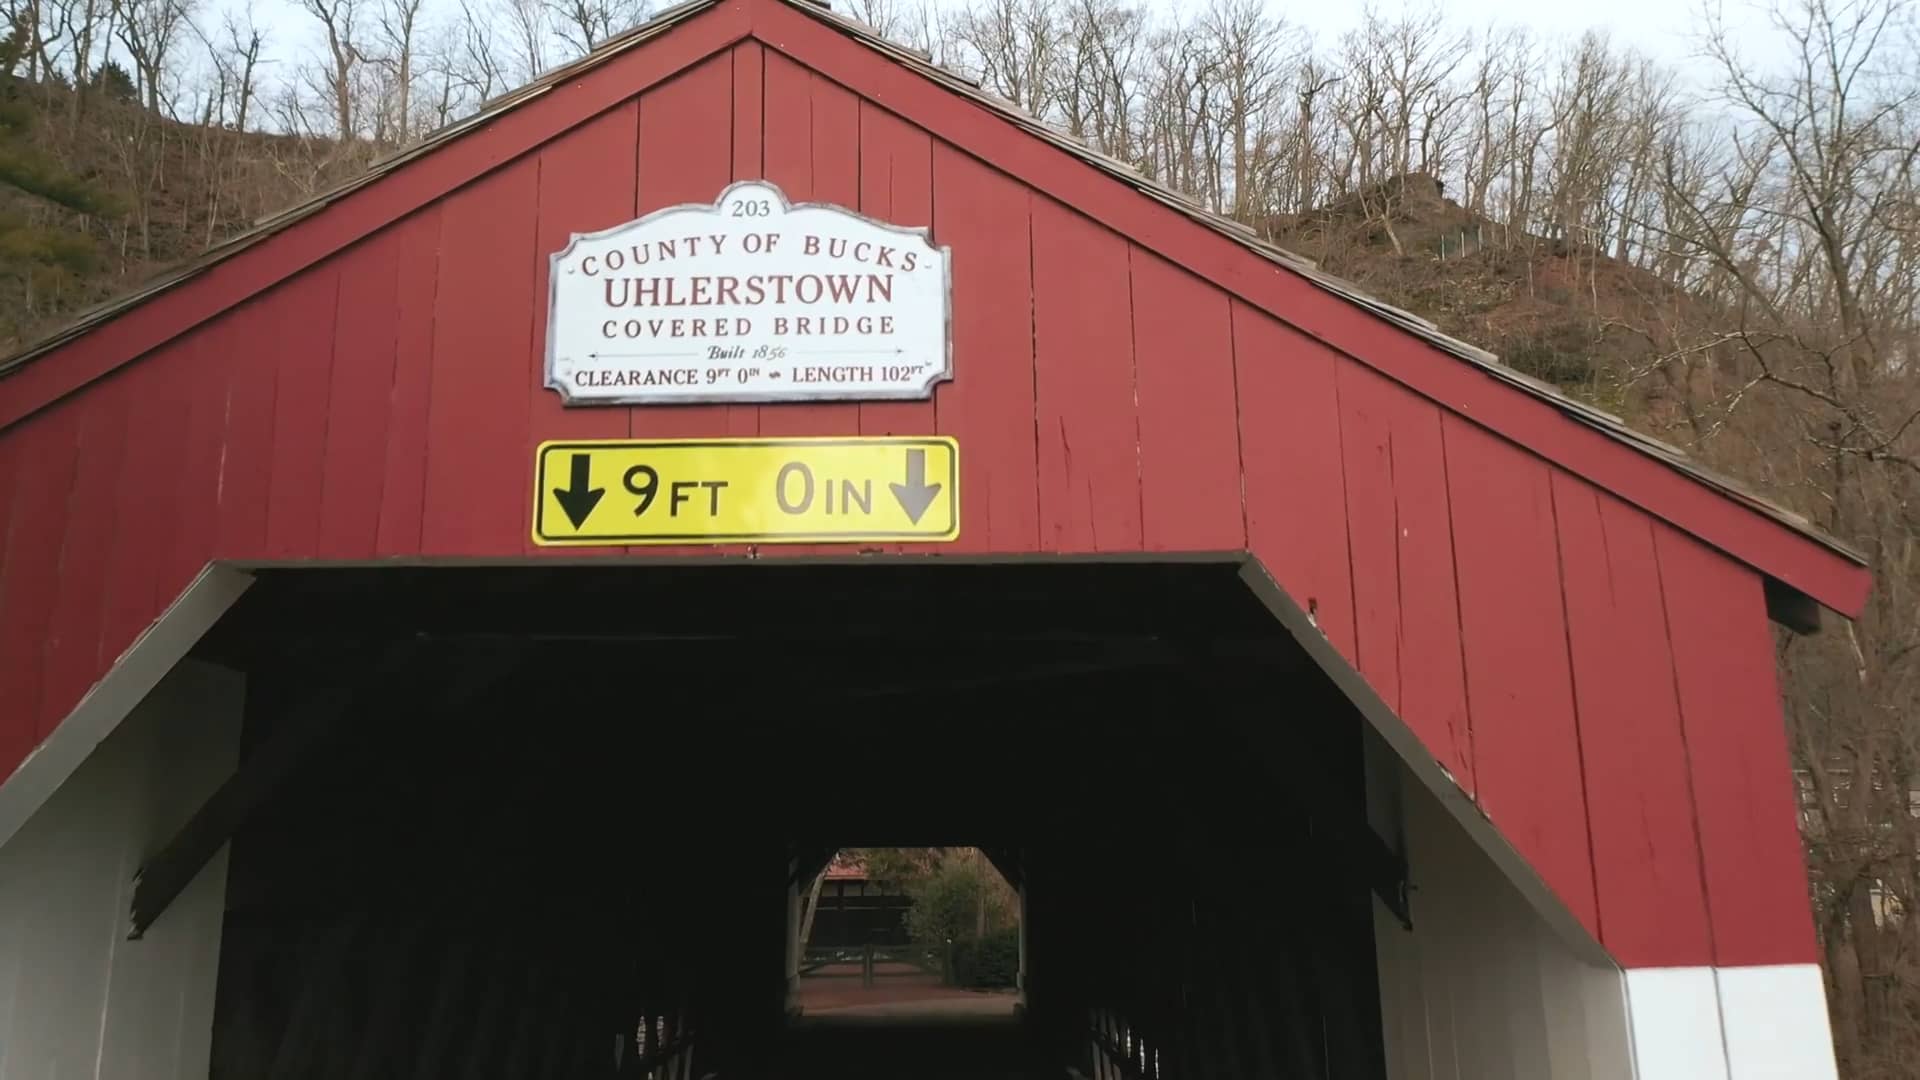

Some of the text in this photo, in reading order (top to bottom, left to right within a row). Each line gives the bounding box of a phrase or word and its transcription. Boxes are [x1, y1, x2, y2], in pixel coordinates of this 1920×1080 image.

[731, 199, 771, 218] 203
[581, 232, 918, 278] COUNTY OF BUCKS
[603, 273, 894, 308] UHLERSTOWN
[602, 316, 895, 339] COVERED BRIDGE
[707, 344, 788, 361] Built 1856
[575, 368, 699, 387] CLEARANCE
[791, 365, 874, 383] LENGTH
